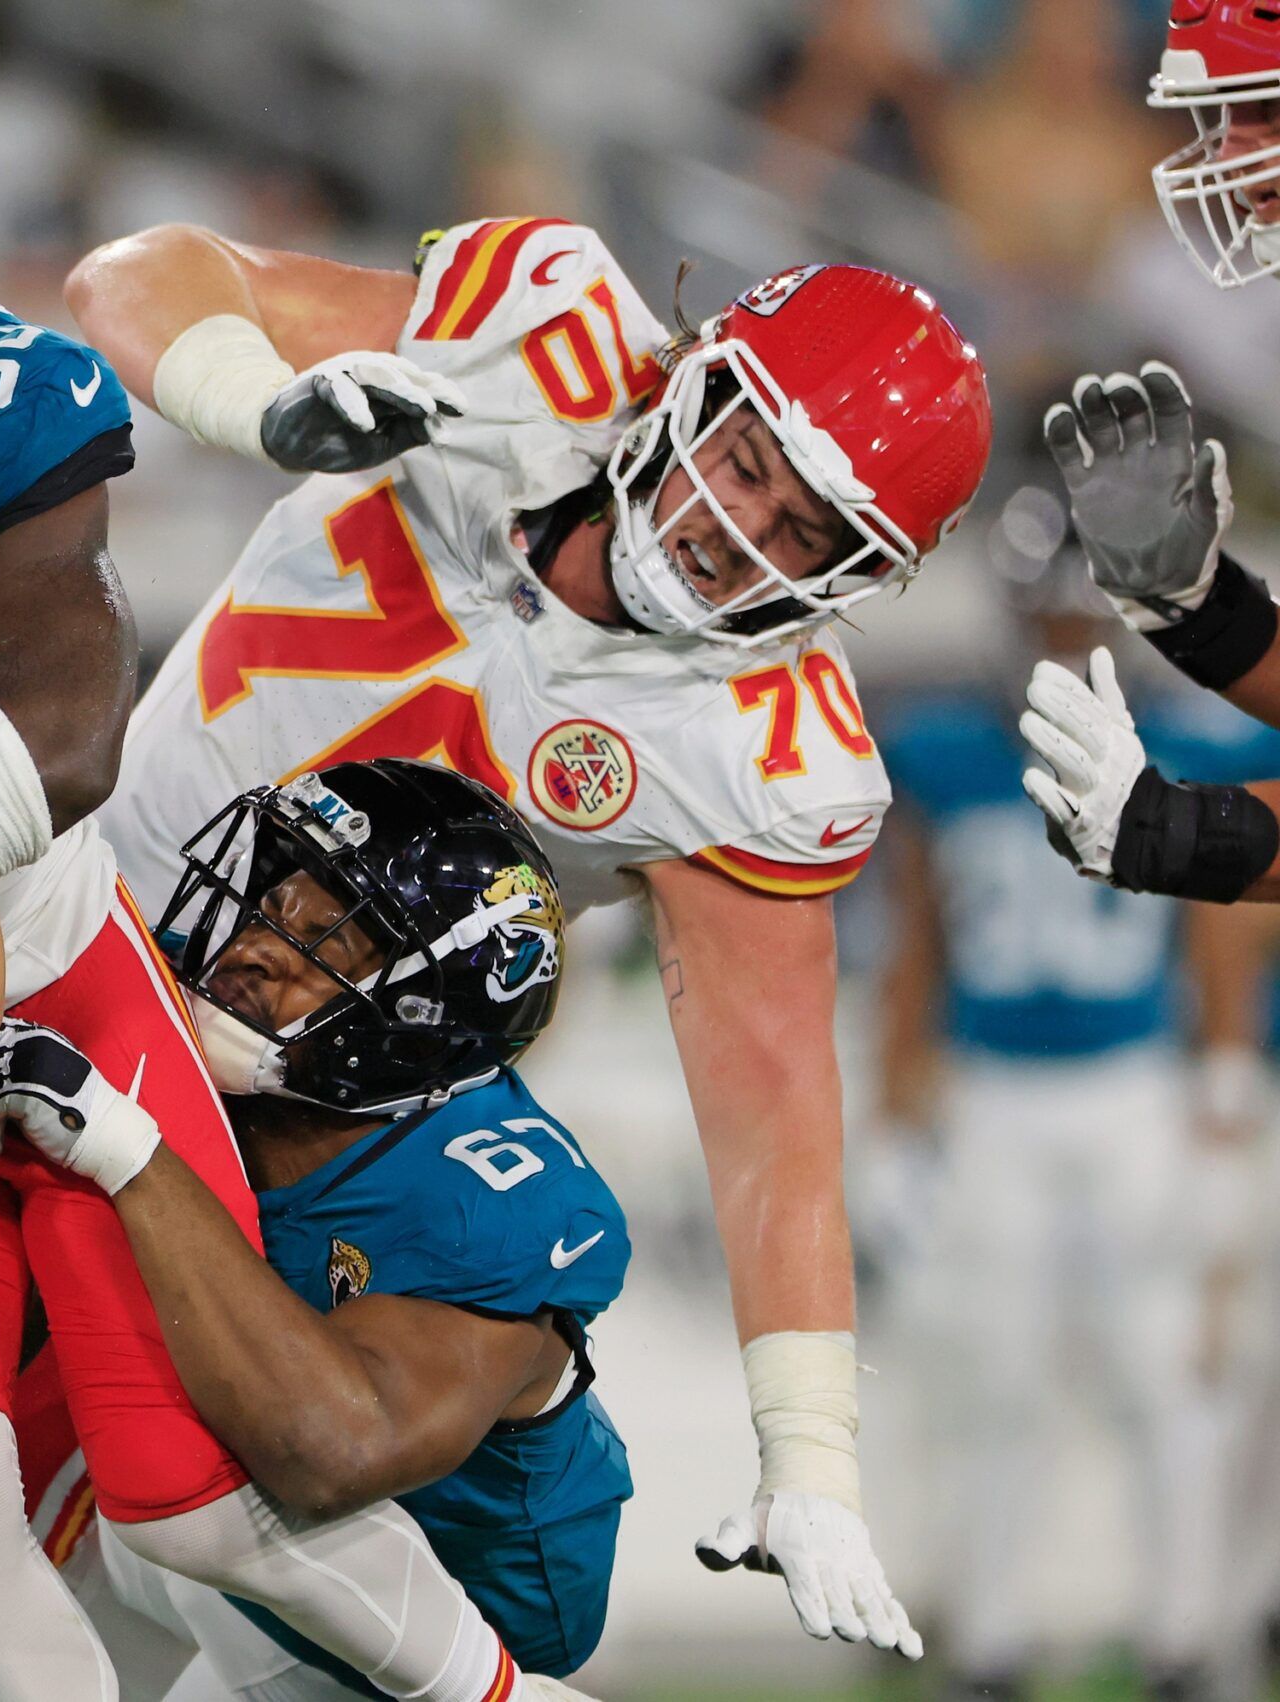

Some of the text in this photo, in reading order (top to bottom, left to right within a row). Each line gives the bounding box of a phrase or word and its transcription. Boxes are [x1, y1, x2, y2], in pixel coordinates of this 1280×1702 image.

[517, 275, 668, 424] 70
[726, 647, 875, 784] 70
[443, 1117, 586, 1192] 67
